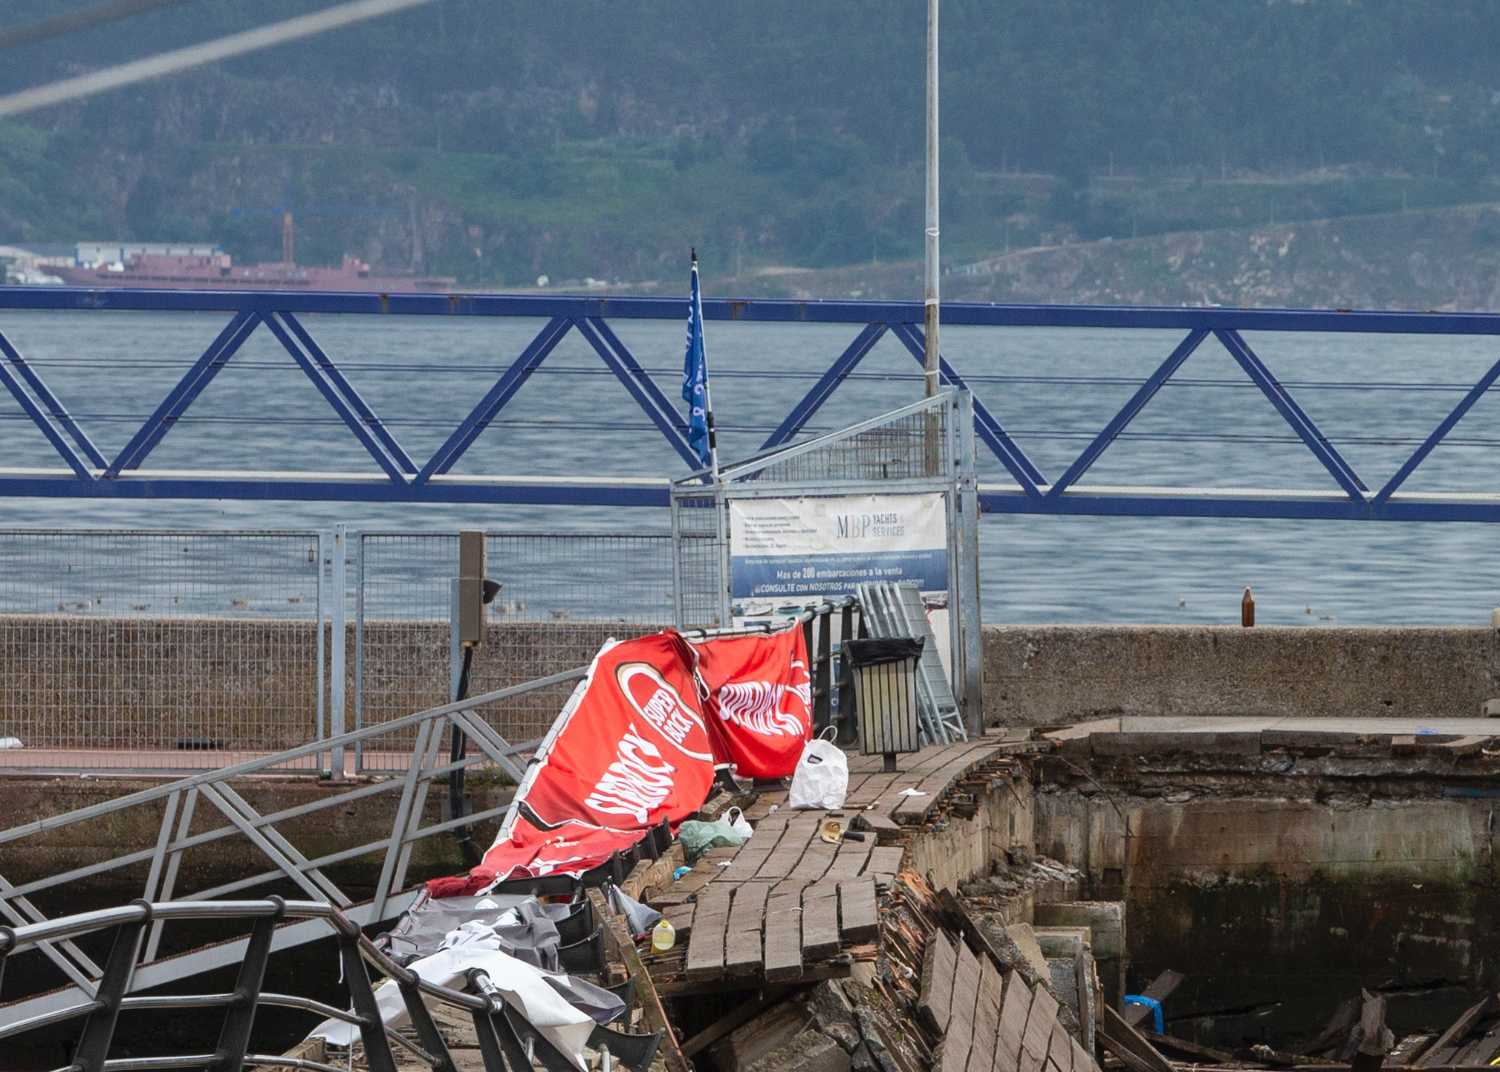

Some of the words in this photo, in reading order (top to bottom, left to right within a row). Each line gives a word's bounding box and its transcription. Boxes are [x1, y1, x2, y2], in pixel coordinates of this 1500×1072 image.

[883, 567, 903, 576] venta
[809, 582, 842, 592] NOSOTROS
[643, 689, 677, 727] SUPER
[663, 707, 695, 744] BOCK
